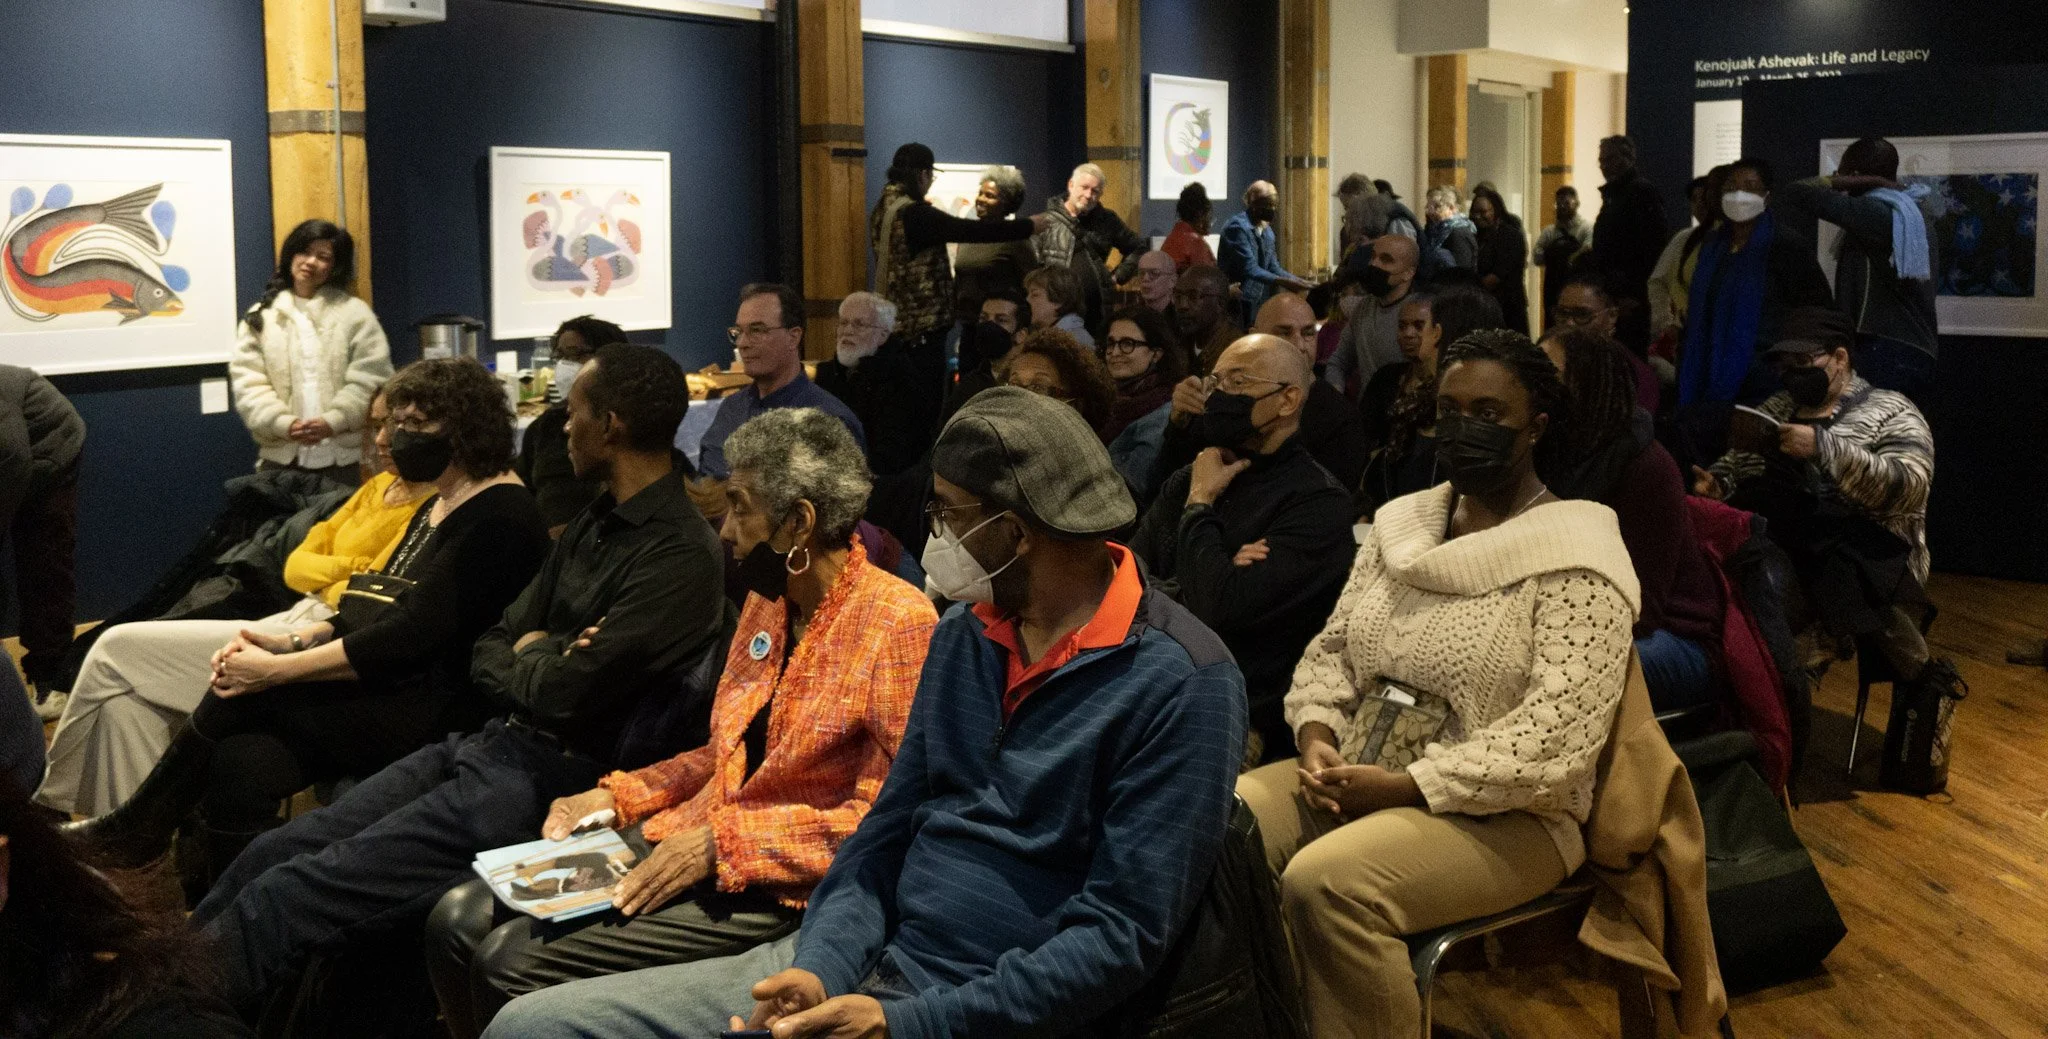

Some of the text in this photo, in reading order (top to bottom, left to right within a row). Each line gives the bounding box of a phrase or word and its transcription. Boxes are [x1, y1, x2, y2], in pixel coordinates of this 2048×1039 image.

[1695, 48, 1930, 73] Kenojuak Ashevak: Life and Legacy
[1695, 77, 1735, 88] January
